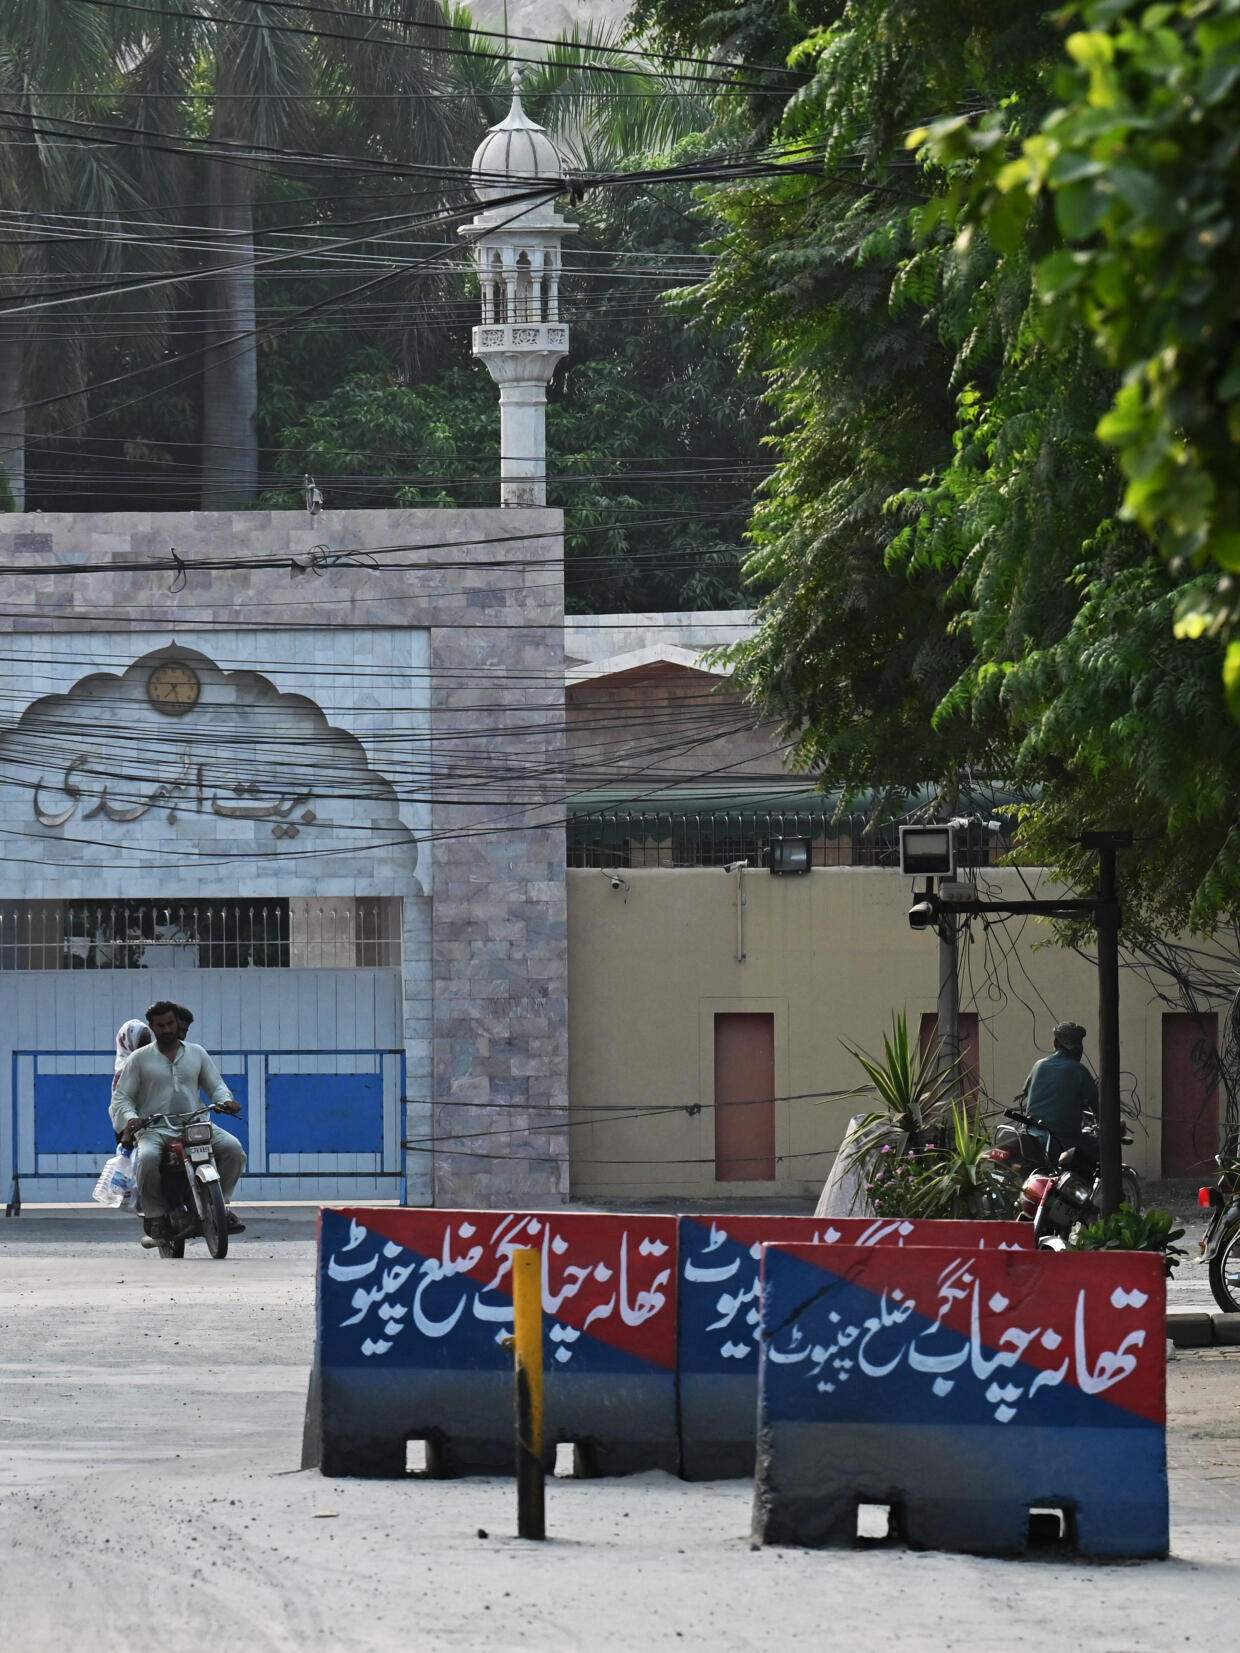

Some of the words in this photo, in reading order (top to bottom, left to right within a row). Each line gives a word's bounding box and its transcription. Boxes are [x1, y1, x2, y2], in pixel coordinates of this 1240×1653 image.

[328, 1217, 416, 1357] چنیوٹ
[413, 1222, 483, 1338] ضلع
[584, 1231, 671, 1330] تھانہ
[859, 1286, 916, 1378] ضلع
[768, 1310, 861, 1393] چنیوٹ
[908, 1278, 1042, 1423] چناب
[1029, 1286, 1148, 1399] تھانہ
